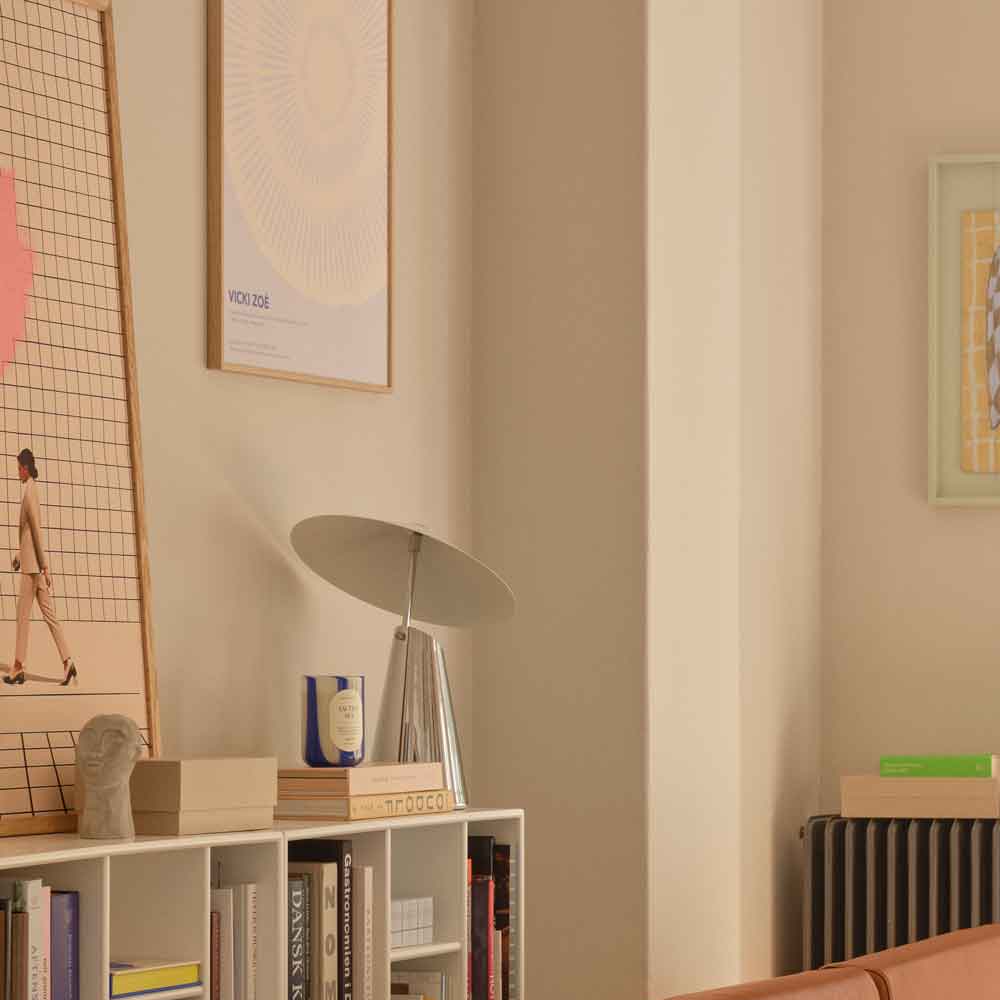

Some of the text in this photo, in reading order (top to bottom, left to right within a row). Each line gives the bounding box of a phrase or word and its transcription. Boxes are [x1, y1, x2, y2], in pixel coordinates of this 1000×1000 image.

[228, 289, 250, 306] VICKI
[292, 890, 303, 977] DANSK
[344, 853, 352, 977] Gastronomien
